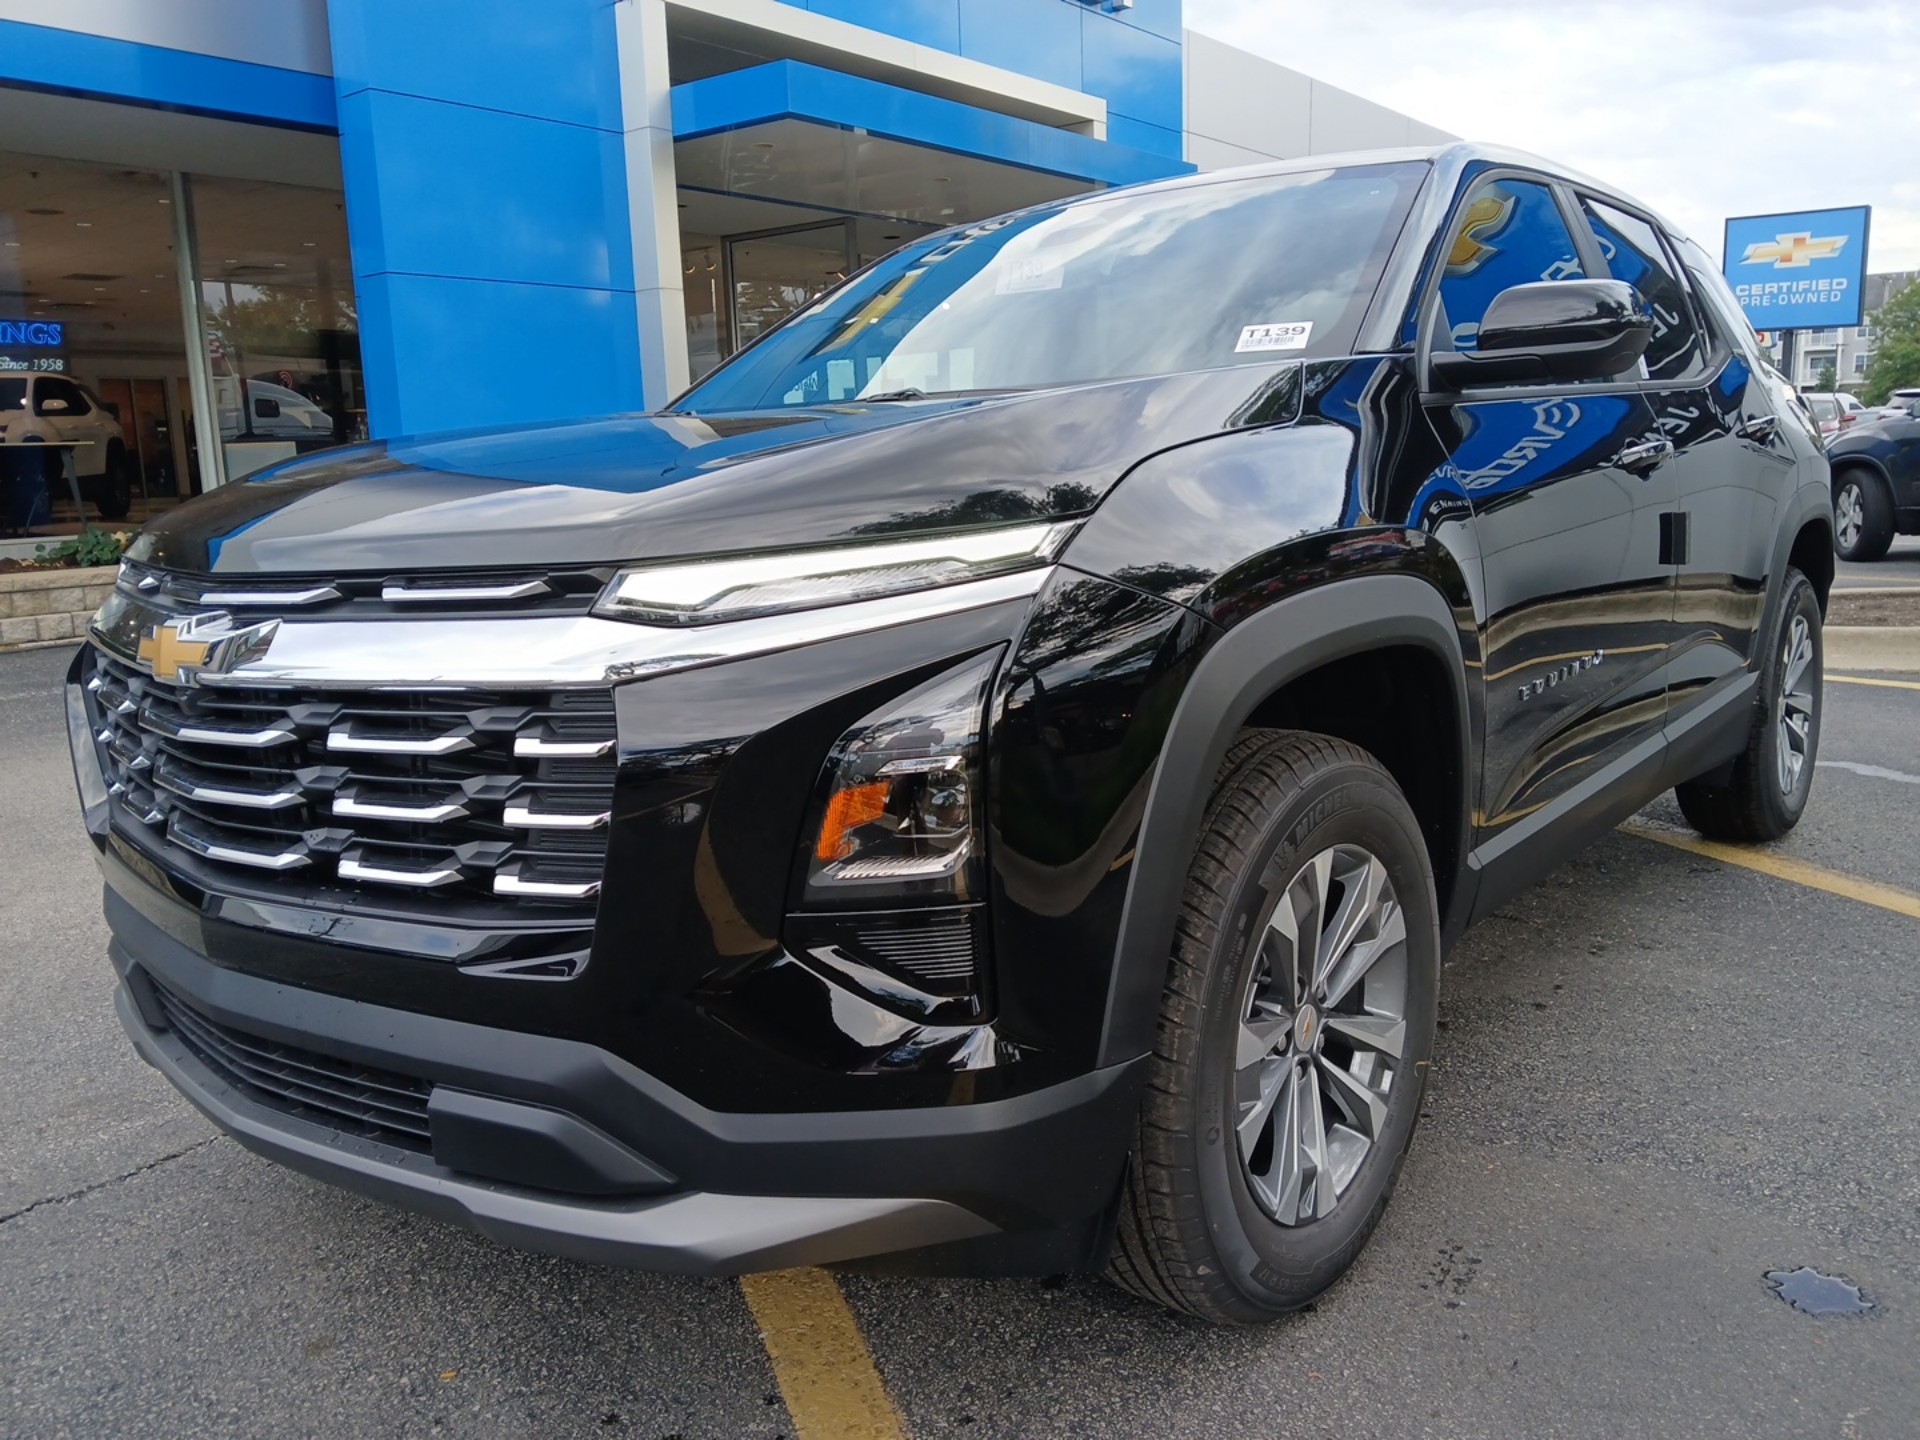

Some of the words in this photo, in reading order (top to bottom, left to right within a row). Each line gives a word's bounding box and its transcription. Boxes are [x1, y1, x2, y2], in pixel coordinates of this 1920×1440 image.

[1736, 278, 1848, 297] CERTIFIED
[1740, 291, 1841, 307] PRE-OWNED
[1246, 326, 1306, 339] T139
[32, 359, 64, 371] 1958
